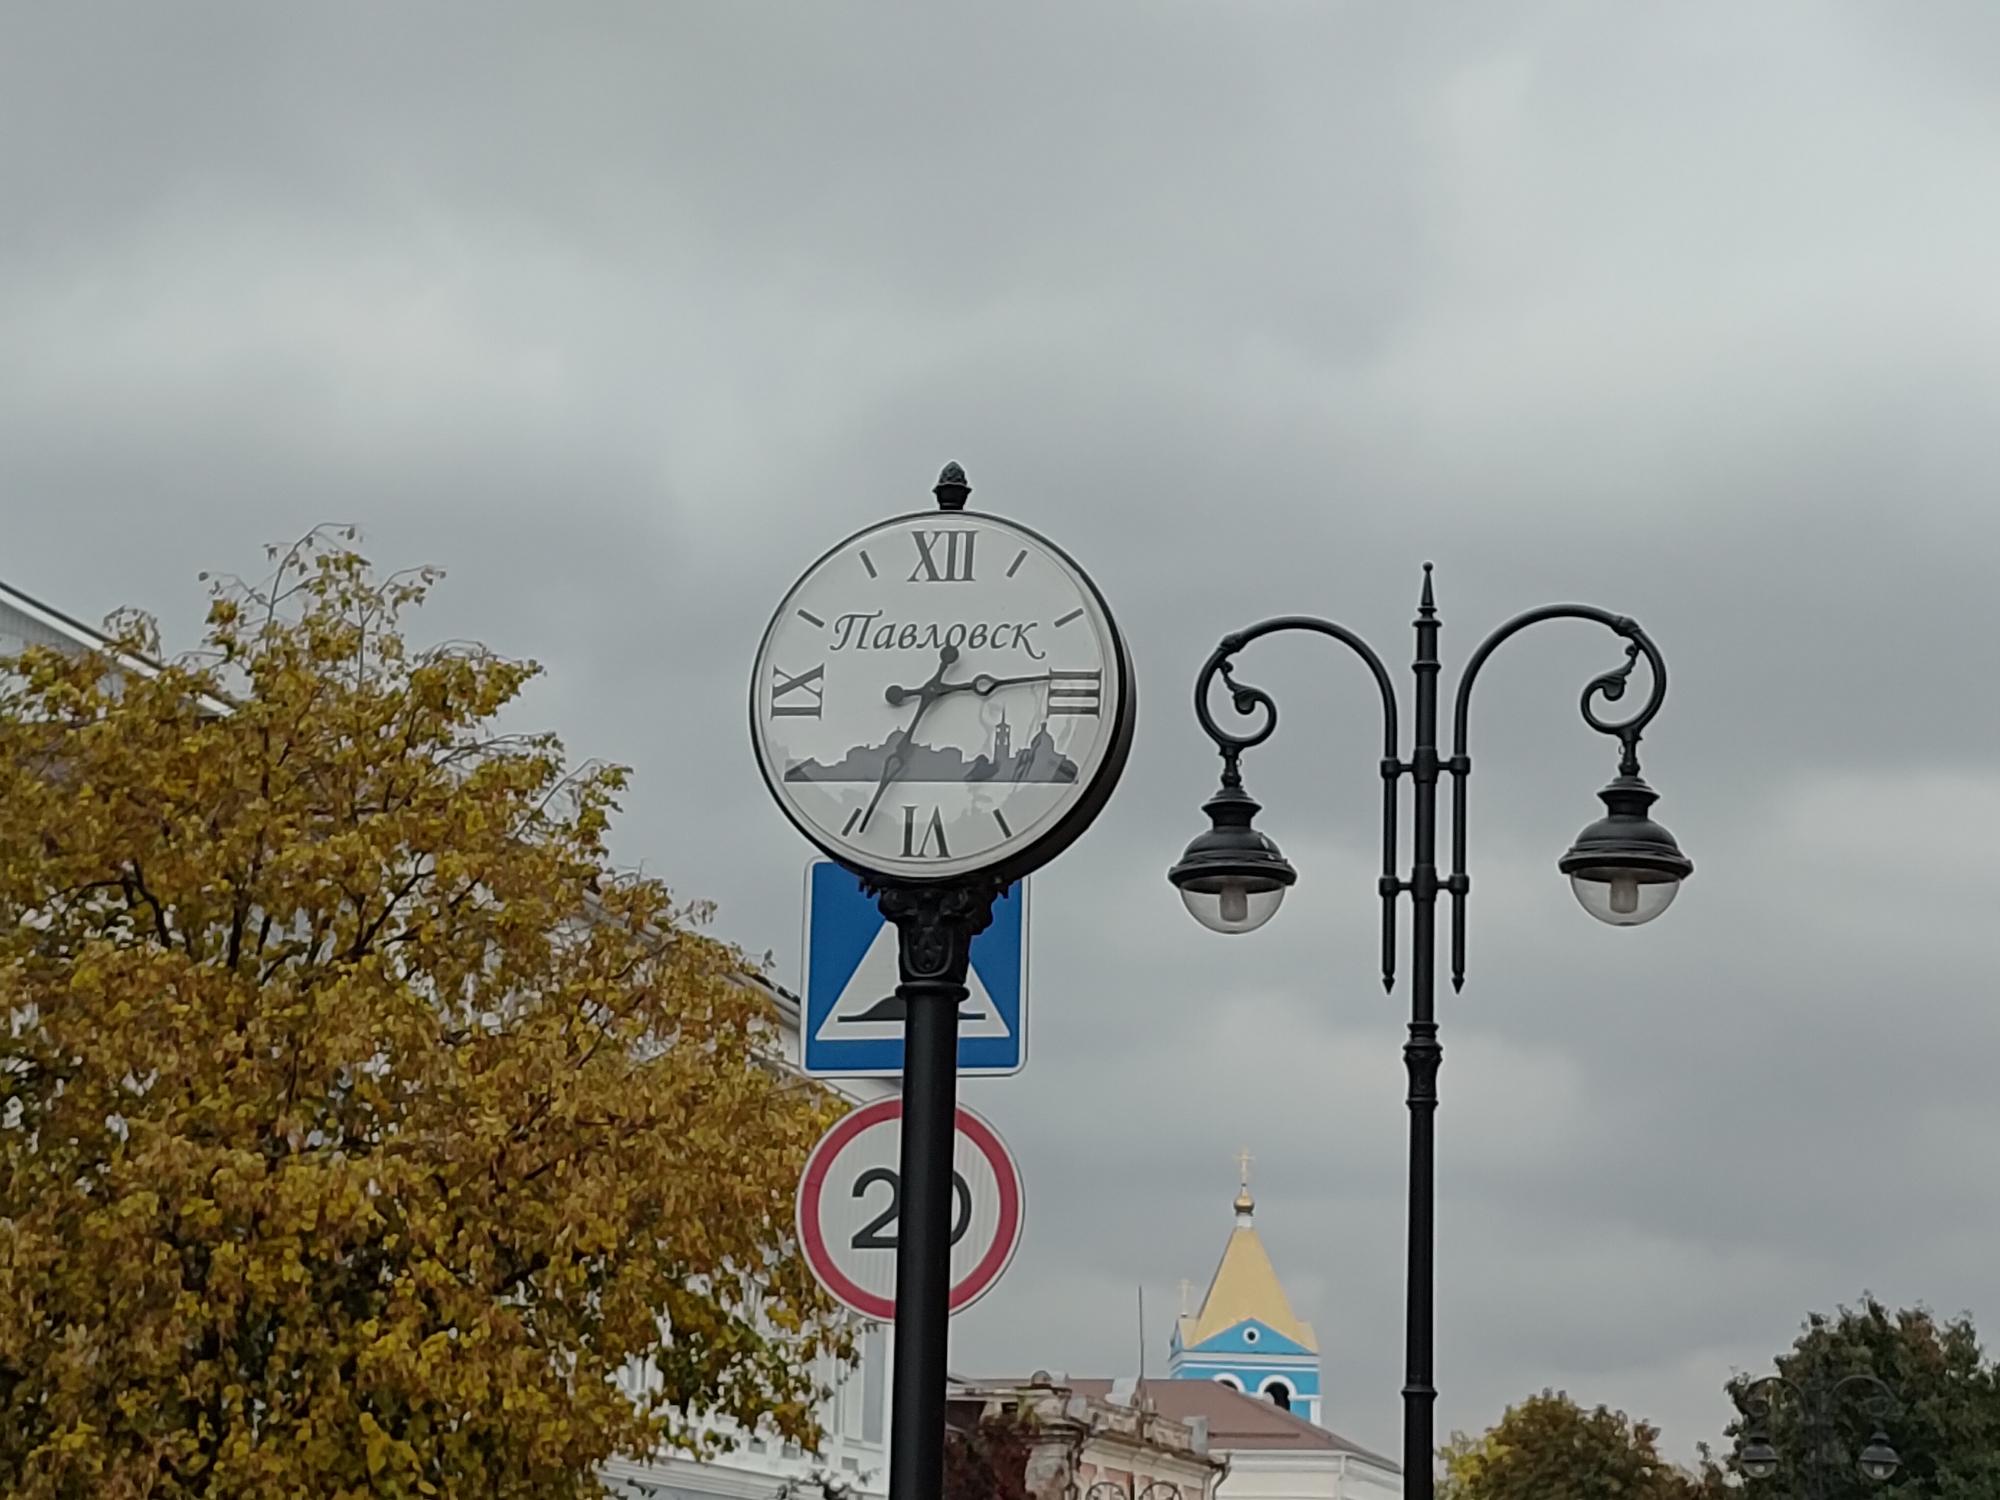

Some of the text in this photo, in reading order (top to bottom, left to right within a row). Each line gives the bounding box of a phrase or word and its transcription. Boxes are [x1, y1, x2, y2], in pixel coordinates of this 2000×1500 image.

[907, 530, 979, 582] XII
[829, 609, 1046, 660] Павловск
[770, 663, 825, 721] IX
[1046, 667, 1102, 720] III
